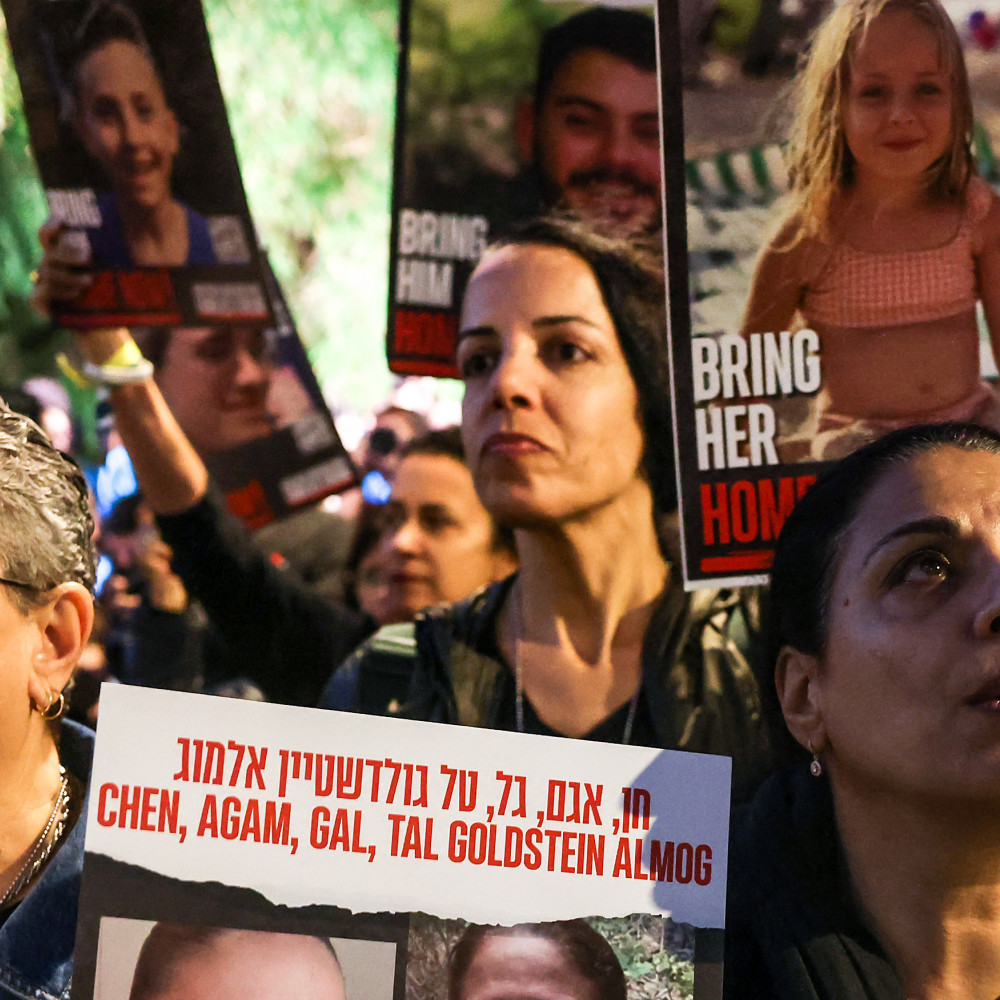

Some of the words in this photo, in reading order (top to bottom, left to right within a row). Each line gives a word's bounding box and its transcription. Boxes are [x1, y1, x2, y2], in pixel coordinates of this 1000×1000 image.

[691, 329, 822, 402] BRING
[695, 403, 779, 471] HER
[173, 737, 269, 790] אלמוג
[278, 748, 429, 808] גולדשטיין
[440, 764, 479, 812] טל
[486, 770, 527, 823] גל,
[536, 779, 604, 828] אגם,
[612, 787, 652, 835] חן,
[96, 782, 188, 843] CHEN,
[196, 794, 299, 855] AGAM,
[309, 806, 376, 863] GAL,
[388, 813, 439, 861] TAL
[448, 820, 606, 876] GOLDSTEIN
[612, 837, 713, 886] ALMOG
